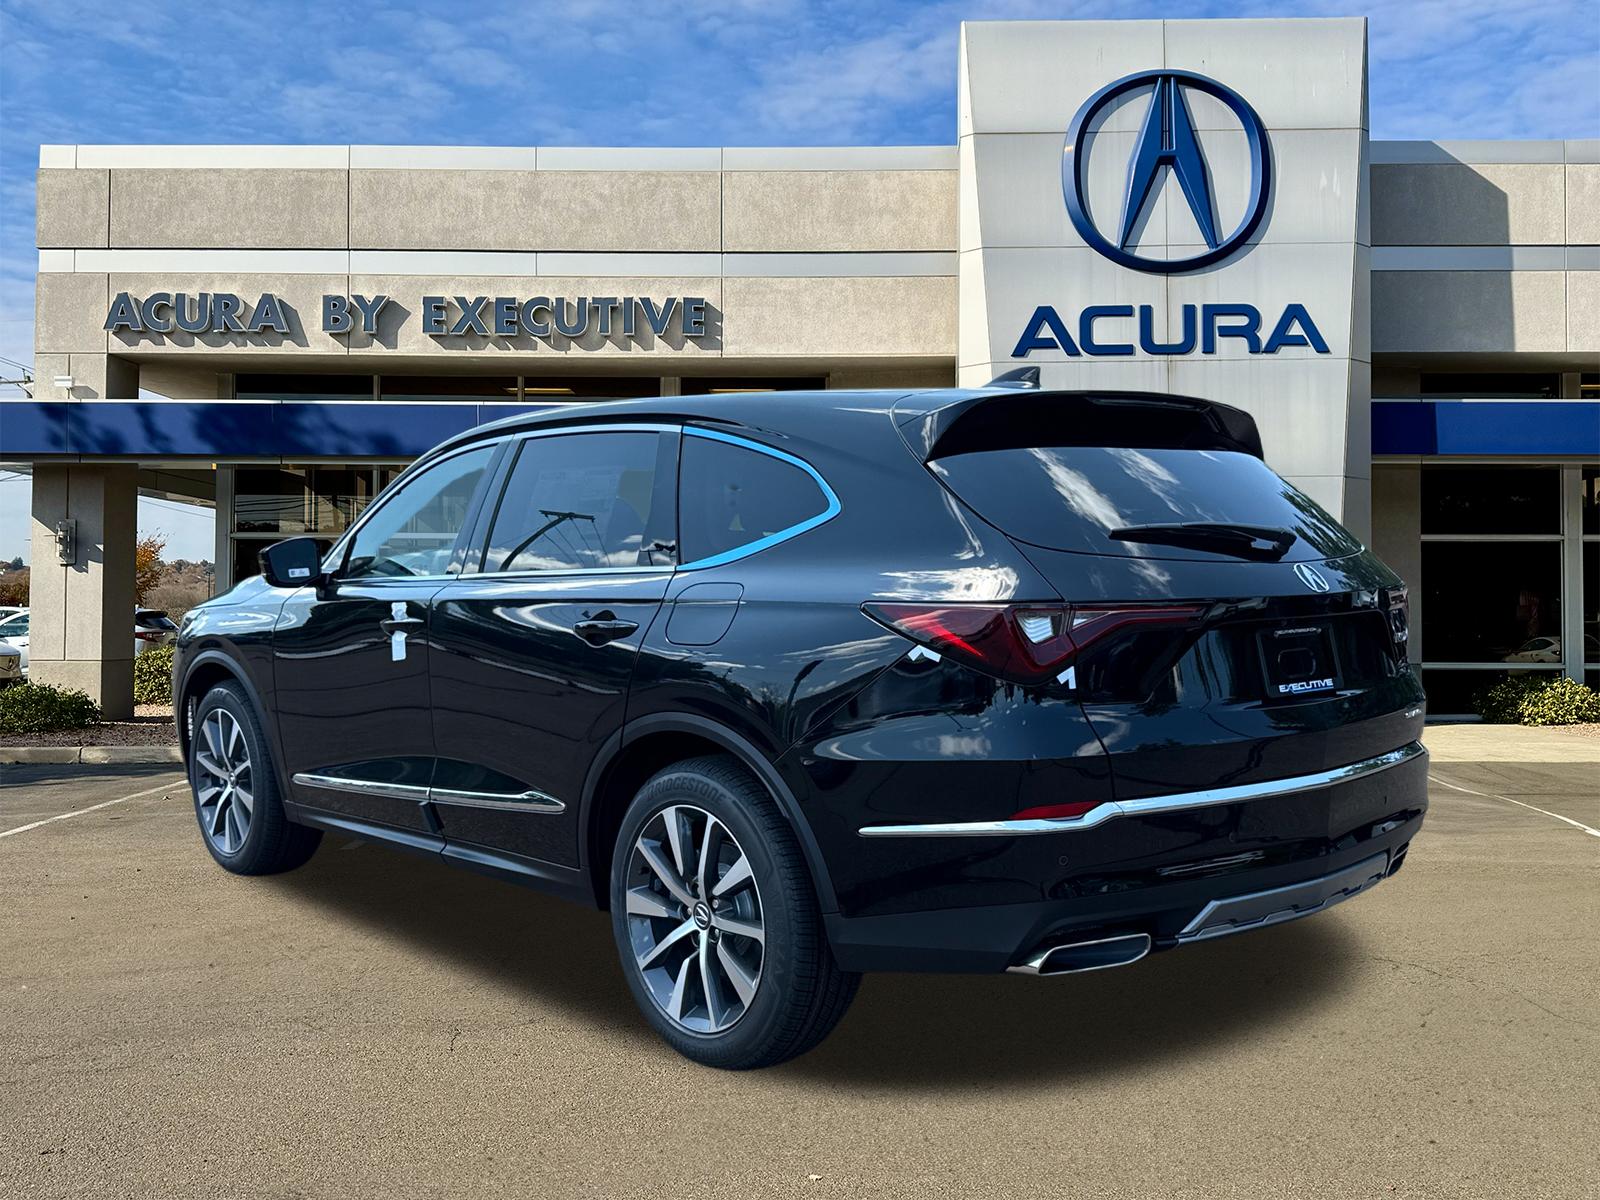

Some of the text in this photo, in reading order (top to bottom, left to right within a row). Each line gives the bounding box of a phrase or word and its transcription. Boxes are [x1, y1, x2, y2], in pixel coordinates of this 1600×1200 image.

[104, 292, 706, 337] ACURA BY EXECUTIVE
[1011, 303, 1332, 357] ACURA
[1278, 678, 1334, 693] EXECUTIVE
[647, 776, 727, 804] BRIDGESTONE
